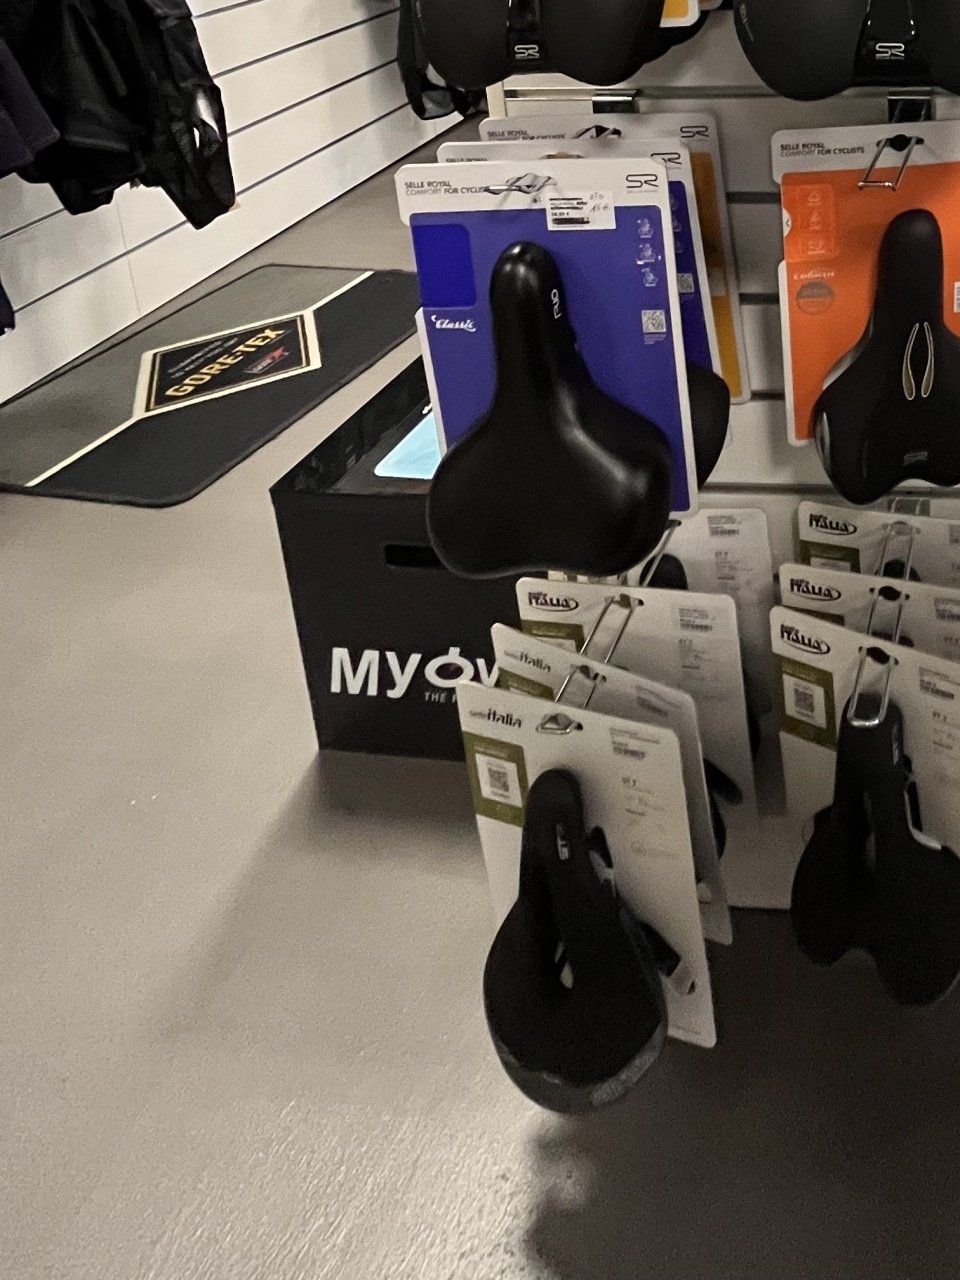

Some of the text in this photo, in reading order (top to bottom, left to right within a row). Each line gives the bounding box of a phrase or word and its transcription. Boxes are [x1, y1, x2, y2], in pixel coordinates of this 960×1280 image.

[780, 141, 824, 152] SELLE ROYAL
[405, 179, 452, 190] SELLE ROYAL
[443, 186, 460, 195] FOR
[430, 314, 477, 333] Classic
[164, 327, 286, 397] GORE-TEX
[424, 691, 446, 703] THE
